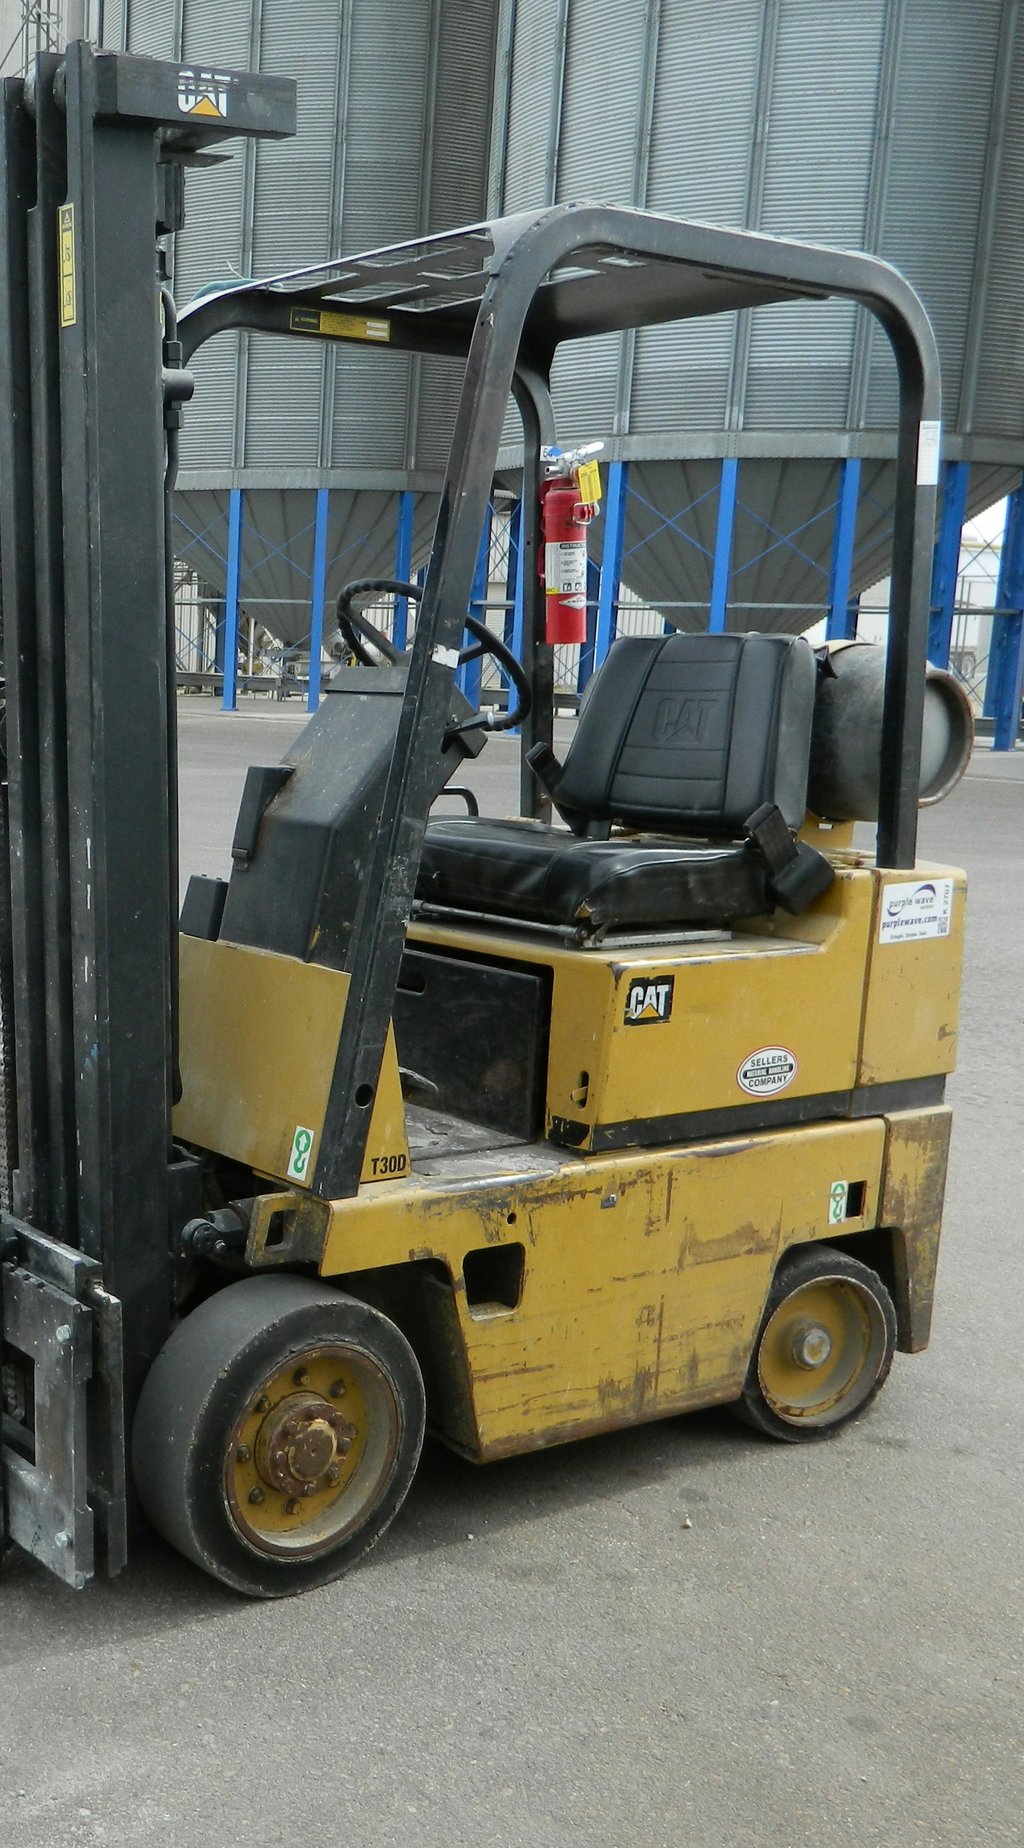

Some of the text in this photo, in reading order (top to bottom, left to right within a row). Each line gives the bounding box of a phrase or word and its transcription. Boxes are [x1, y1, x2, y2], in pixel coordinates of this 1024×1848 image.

[652, 698, 718, 743] CAT
[889, 898, 913, 908] purple
[914, 896, 934, 905] wave
[881, 915, 938, 931] purplewave.com
[629, 984, 671, 1020] CAT
[751, 1055, 788, 1067] SELLERS
[749, 1075, 788, 1087] COMPANY
[370, 1153, 407, 1175] T30D
